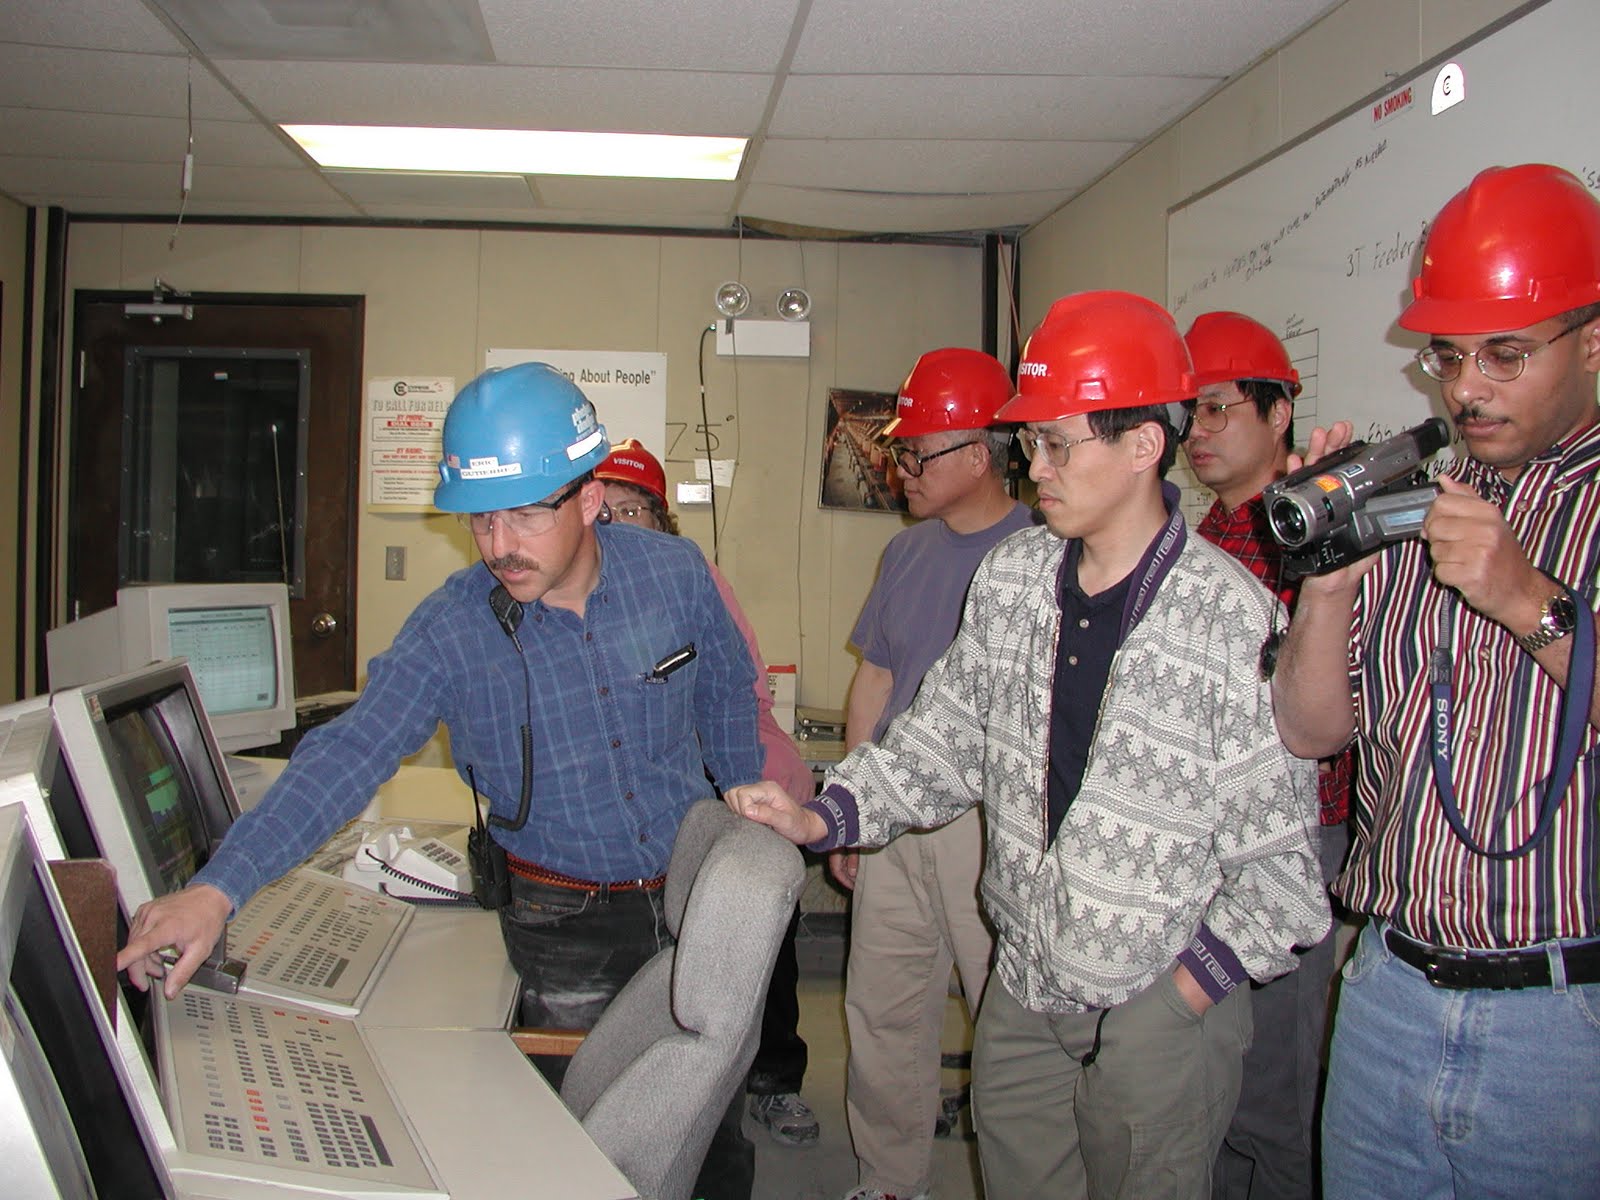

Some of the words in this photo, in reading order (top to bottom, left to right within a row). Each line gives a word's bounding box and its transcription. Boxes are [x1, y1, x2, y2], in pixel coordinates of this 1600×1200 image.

[1372, 104, 1383, 122] NO
[1384, 87, 1412, 117] SMOKING
[580, 369, 611, 383] About
[613, 457, 645, 470] VISITOR
[1437, 699, 1448, 760] SONY
